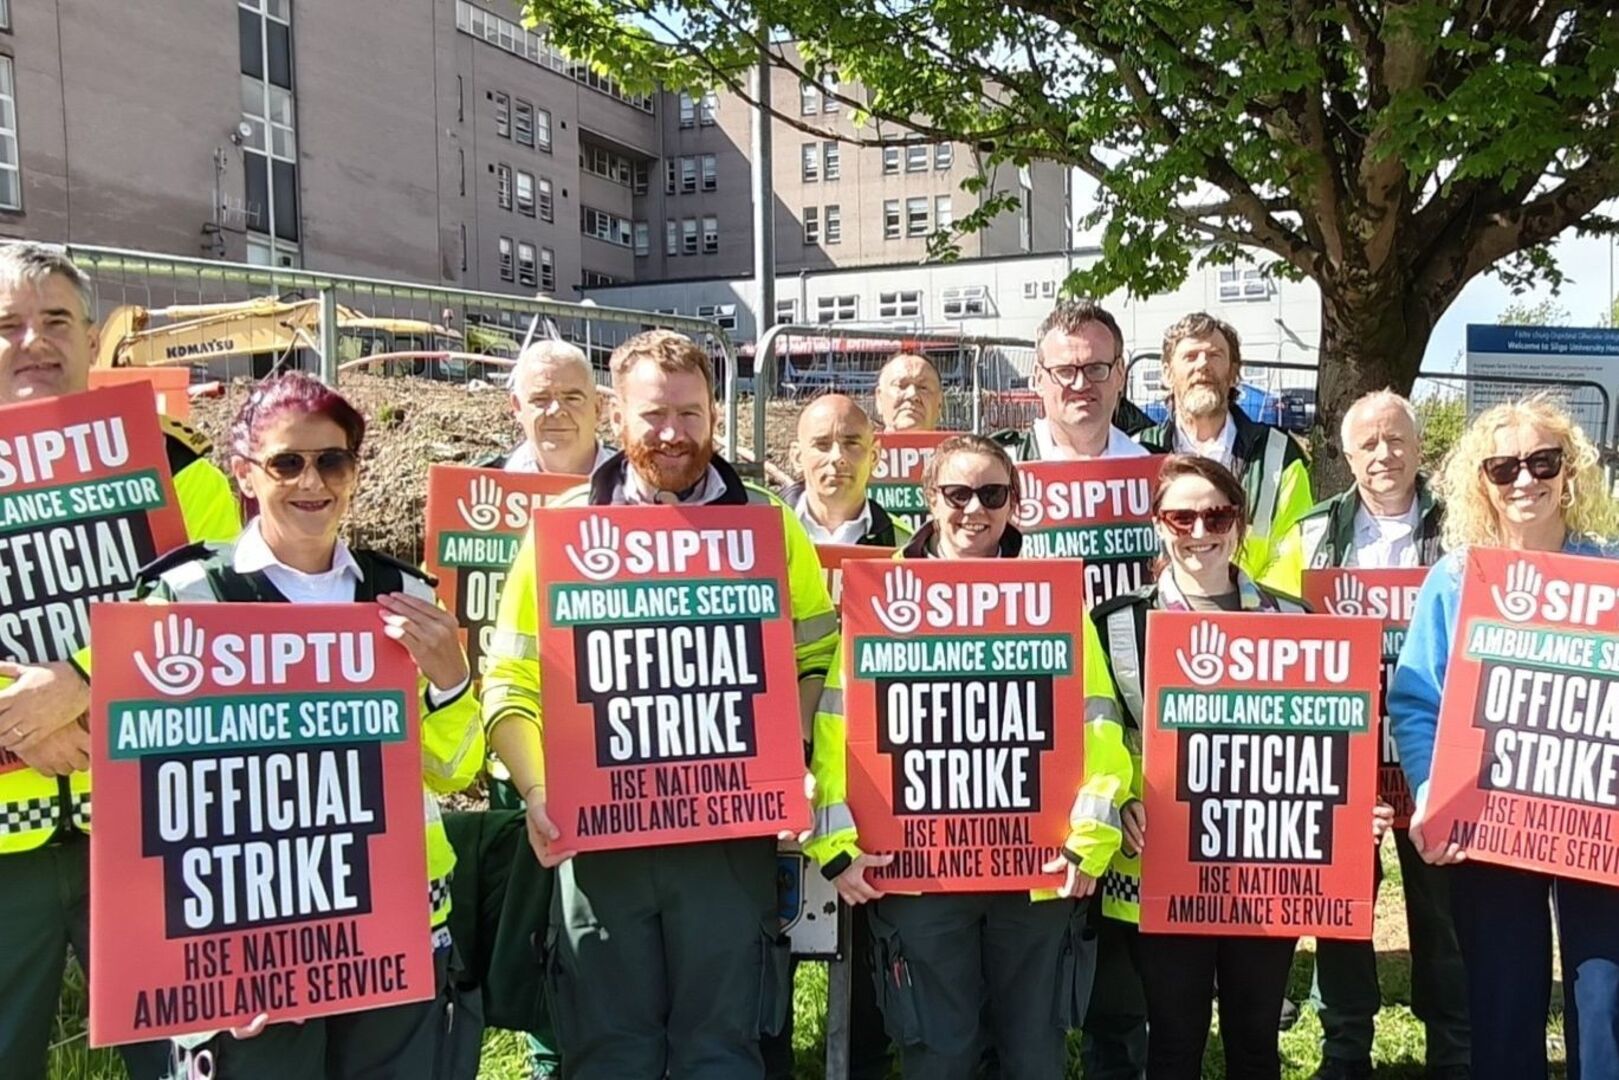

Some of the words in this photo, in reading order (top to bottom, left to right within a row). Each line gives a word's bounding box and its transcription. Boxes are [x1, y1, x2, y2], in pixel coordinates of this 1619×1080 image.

[166, 339, 234, 359] KOMATSU
[1507, 341, 1540, 351] Welcome
[70, 477, 160, 514] SECTOR
[1046, 478, 1150, 520] SIPTU
[624, 529, 755, 573] SIPTU
[555, 588, 691, 621] AMBULANCE
[696, 585, 776, 615] SECTOR
[926, 582, 1051, 628] SIPTU
[1541, 579, 1619, 625] SIP
[211, 631, 375, 687] SIPTU
[586, 625, 758, 693] OFFICIAL
[860, 641, 985, 673] AMBULANCE
[992, 639, 1068, 670] SECTOR
[1228, 638, 1351, 683] SIPTU
[1469, 625, 1597, 668] AMBULANCE
[118, 702, 290, 750] AMBULANCE
[299, 699, 401, 739] SECTOR
[607, 691, 747, 762] STRIKE
[887, 681, 1046, 744] OFFICIAL
[1162, 693, 1284, 725] AMBULANCE
[1290, 695, 1365, 727] SECTOR
[610, 767, 647, 801] HSE
[655, 761, 752, 796] NATIONAL
[904, 747, 1031, 811] STRIKE
[1187, 733, 1340, 796] OFFICIAL
[1490, 728, 1617, 806] STRIKE
[157, 749, 375, 842] OFFICIAL
[576, 801, 700, 838] AMBULANCE
[708, 791, 788, 825] SERVICE
[1483, 794, 1520, 826] HSE
[1523, 801, 1613, 842] NATIONAL
[904, 818, 938, 848] HSE
[945, 816, 1033, 846] NATIONAL
[1200, 799, 1323, 861] STRIKE
[1447, 819, 1560, 864] AMBULANCE
[182, 832, 359, 930] STRIKE
[1199, 866, 1230, 895] HSE
[1238, 866, 1323, 896] NATIONAL
[1167, 896, 1274, 925] AMBULANCE
[1281, 897, 1353, 926] SERVICE
[184, 937, 233, 982] HSE
[243, 920, 364, 972] NATIONAL
[133, 969, 299, 1030] AMBULANCE
[307, 953, 409, 1004] SERVICE
